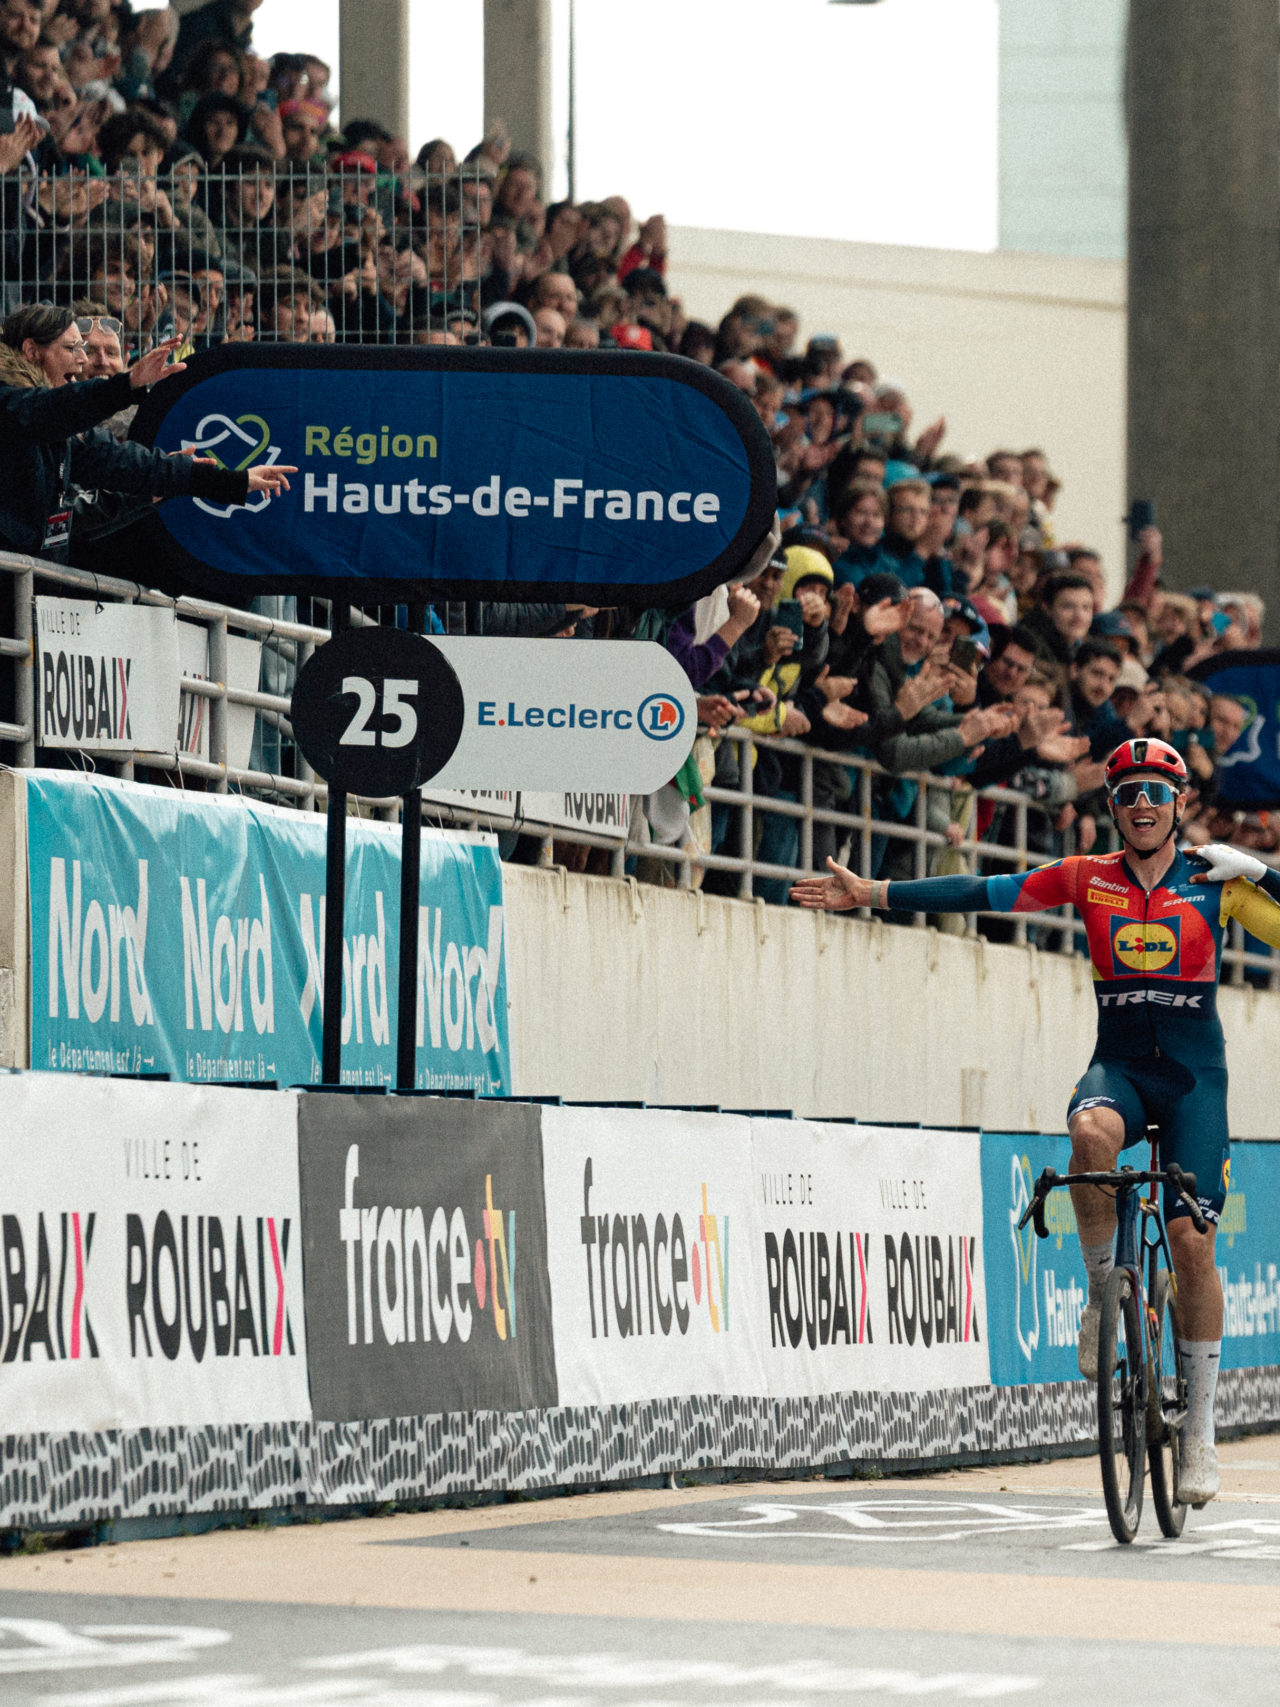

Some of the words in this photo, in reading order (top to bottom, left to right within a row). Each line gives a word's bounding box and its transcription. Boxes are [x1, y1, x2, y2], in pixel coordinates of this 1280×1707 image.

[304, 425, 438, 465] Région
[303, 472, 721, 524] Hauts-de-France
[41, 608, 66, 634] VILLE
[70, 611, 81, 635] DE
[43, 650, 132, 741] ROUBAIX
[339, 676, 419, 748] 25
[477, 701, 633, 730] E.Leclerc
[1089, 875, 1130, 894] Santini
[48, 857, 154, 1027] Nord
[180, 874, 275, 1034] Nord
[416, 904, 501, 1054] Nord
[1099, 990, 1204, 1008] TREK
[124, 1138, 171, 1180] VILLE
[180, 1140, 202, 1181] DE
[762, 1173, 793, 1205] VILLE
[800, 1173, 812, 1206] DE
[878, 1179, 909, 1210] VILLE
[913, 1180, 927, 1210] DE
[126, 1209, 296, 1363] ROUBAIX
[765, 1228, 874, 1351] ROUBAIX
[884, 1231, 980, 1349] ROUBAIX
